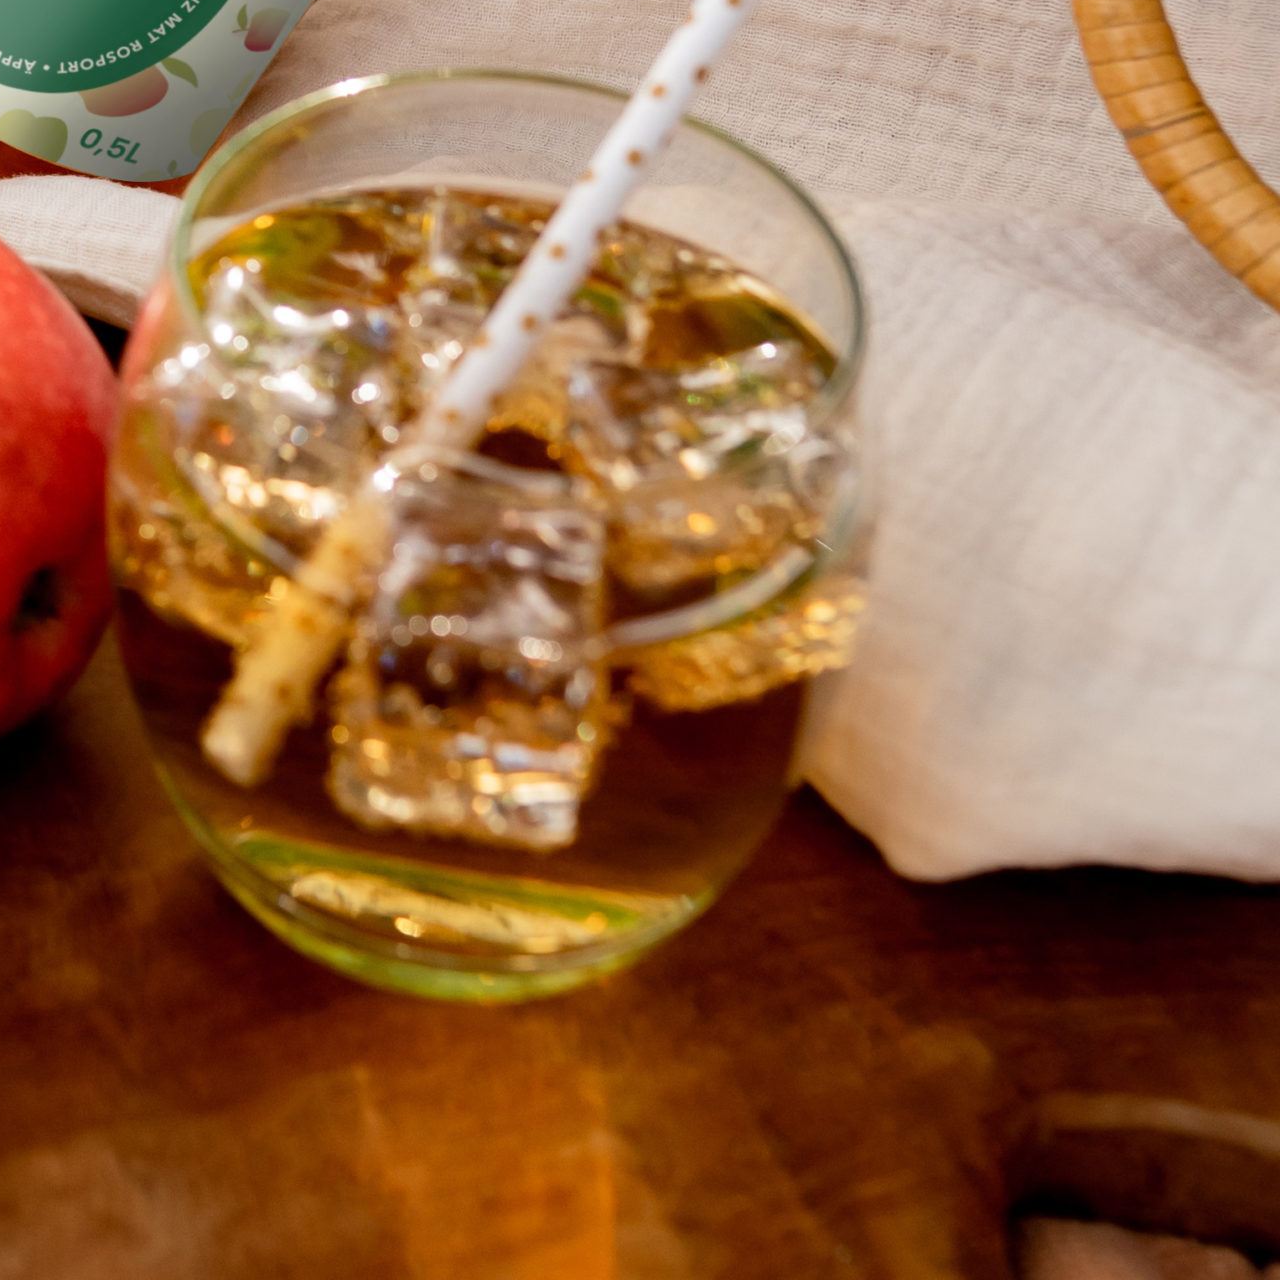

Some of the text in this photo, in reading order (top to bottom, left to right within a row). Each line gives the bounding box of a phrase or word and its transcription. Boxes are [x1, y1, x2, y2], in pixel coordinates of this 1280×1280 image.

[146, 12, 183, 44] MAT
[56, 39, 143, 74] ROSPORT
[79, 127, 141, 165] 0,5L
